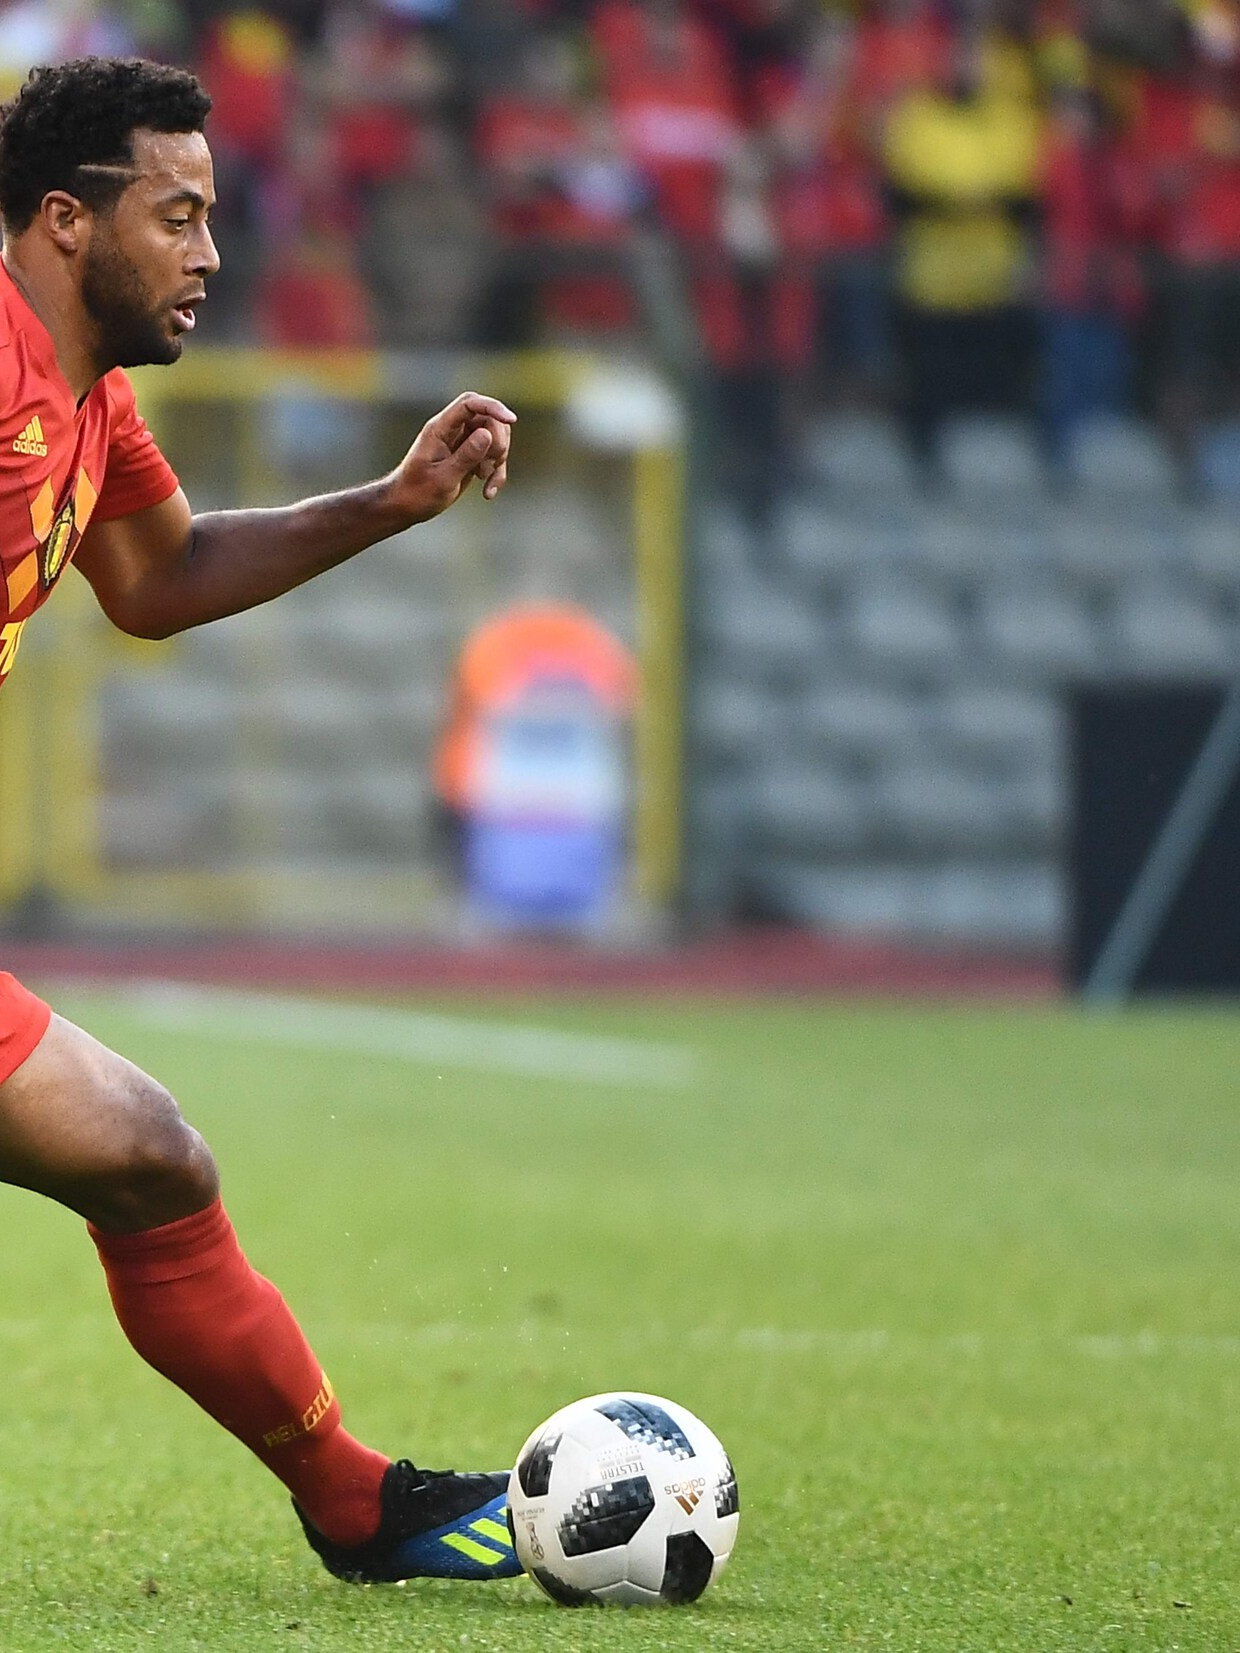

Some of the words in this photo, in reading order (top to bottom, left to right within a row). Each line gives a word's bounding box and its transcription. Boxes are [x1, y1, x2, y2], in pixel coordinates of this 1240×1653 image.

[12, 439, 48, 457] adidas
[262, 1368, 334, 1447] BELGIU
[664, 1477, 706, 1495] adidas
